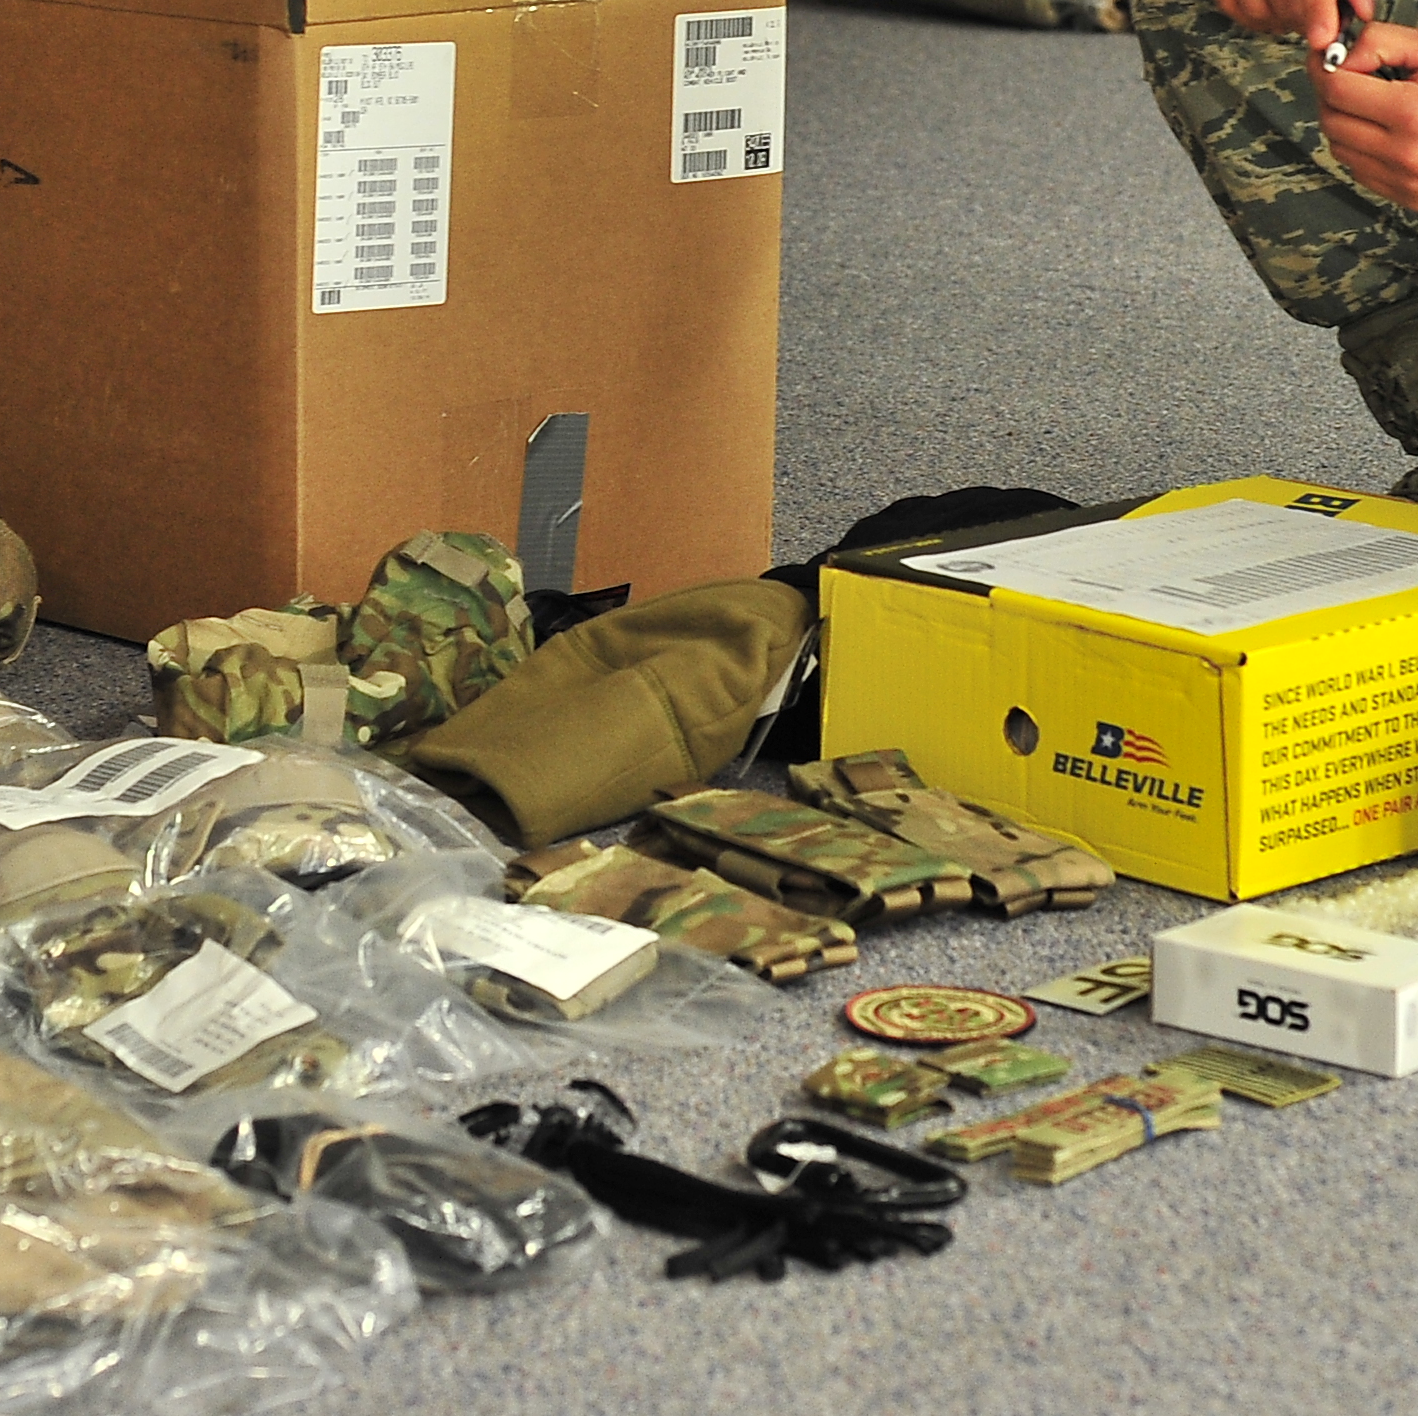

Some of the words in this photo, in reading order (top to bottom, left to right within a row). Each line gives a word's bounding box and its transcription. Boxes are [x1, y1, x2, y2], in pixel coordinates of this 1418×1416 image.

[1263, 685, 1302, 711] SINCE
[1306, 673, 1352, 699] WORLD
[1355, 664, 1385, 686] WAR
[1262, 716, 1289, 739] THE
[1292, 705, 1336, 731] NEEDS
[1340, 697, 1368, 719] AND
[1262, 746, 1289, 768] OUR
[1293, 721, 1381, 759] COMMITMENT
[1384, 716, 1400, 735] TO
[1052, 752, 1205, 809] BELLEVILLE
[1262, 772, 1291, 796] THIS
[1325, 740, 1412, 779] EVERYWHERE
[1260, 799, 1296, 824] WHAT
[1300, 782, 1361, 813] HAPPENS
[1364, 770, 1402, 795] WHEN
[1353, 804, 1379, 826] ONE
[1383, 795, 1412, 819] PAIR
[1237, 988, 1312, 1033] SOG
